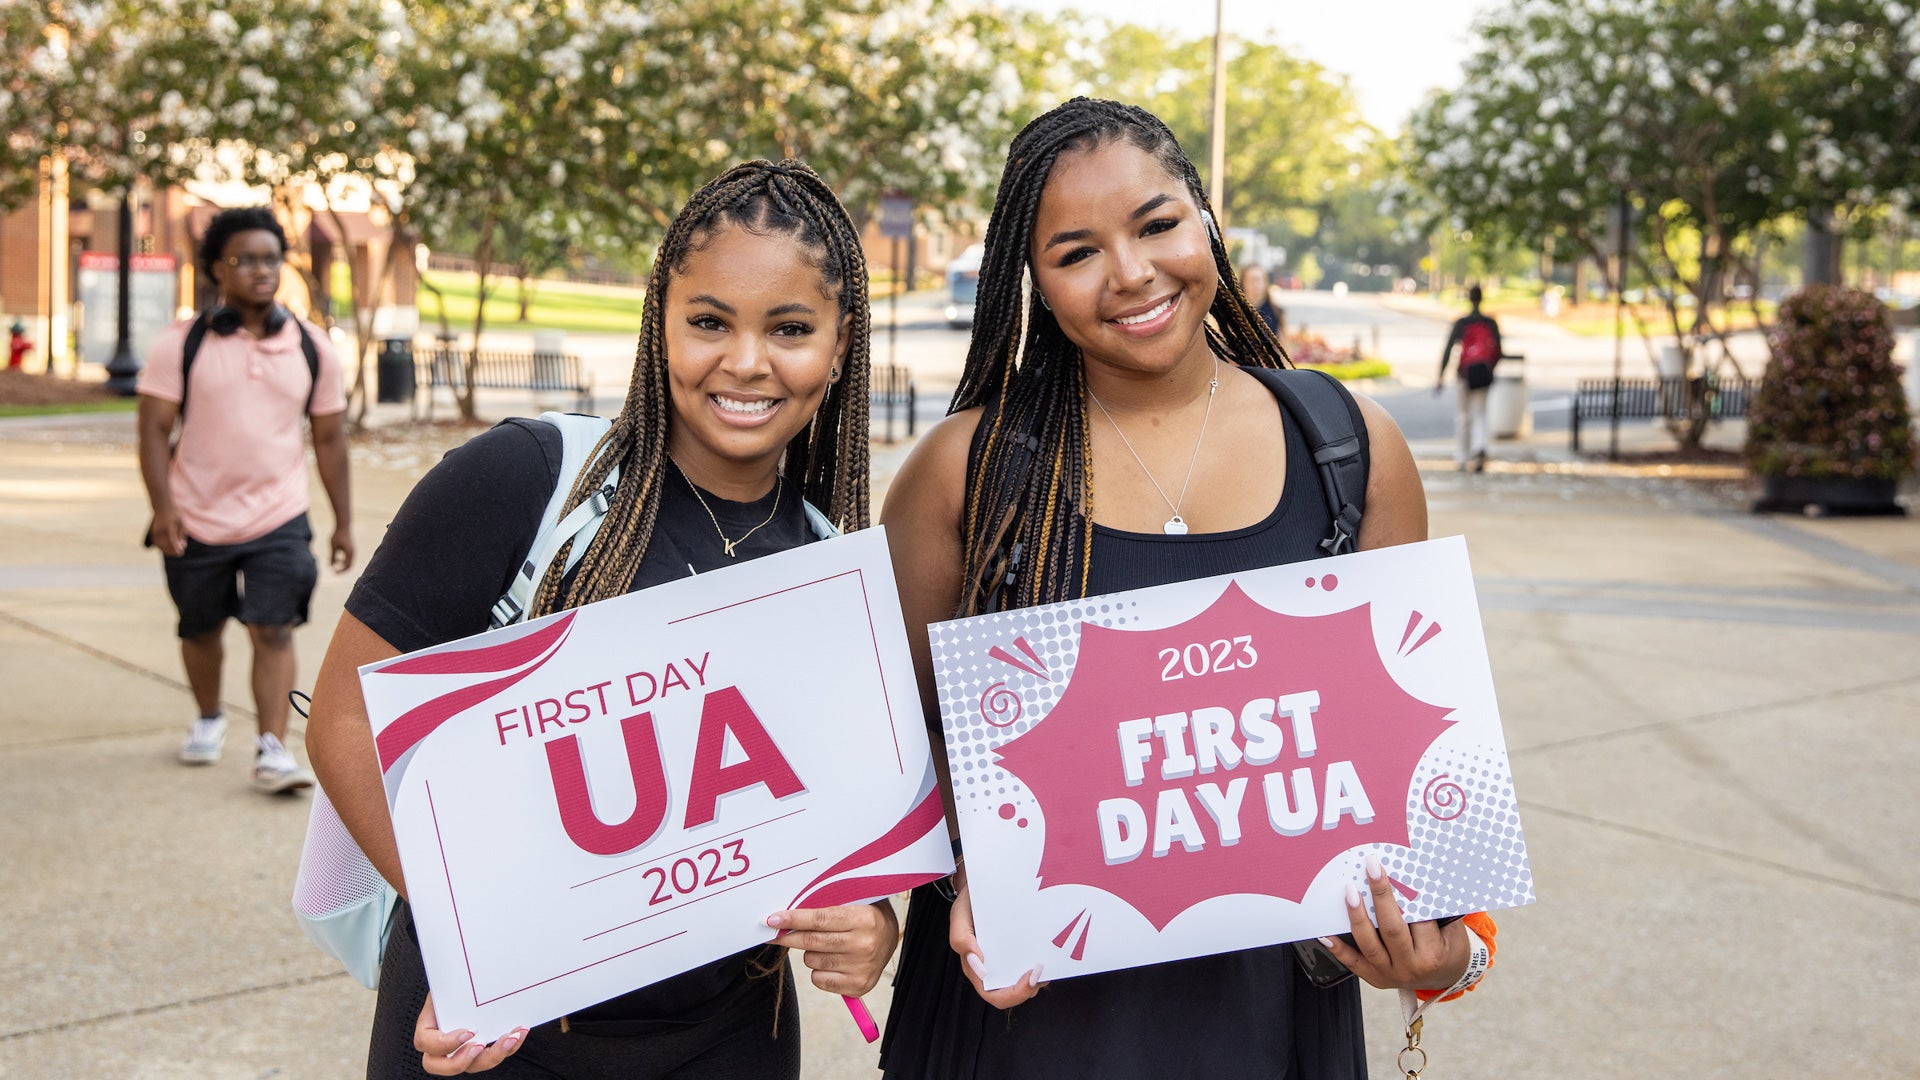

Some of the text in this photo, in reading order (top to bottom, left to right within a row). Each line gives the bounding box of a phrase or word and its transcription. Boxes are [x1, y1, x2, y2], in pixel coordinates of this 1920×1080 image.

[495, 652, 710, 746] FIRST DAY
[1158, 635, 1259, 682] 2023
[544, 685, 808, 856] UA
[1117, 690, 1320, 787] FIRST
[1097, 760, 1375, 865] DAY UA
[642, 839, 750, 906] 2023
[1479, 948, 1487, 966] GOD
